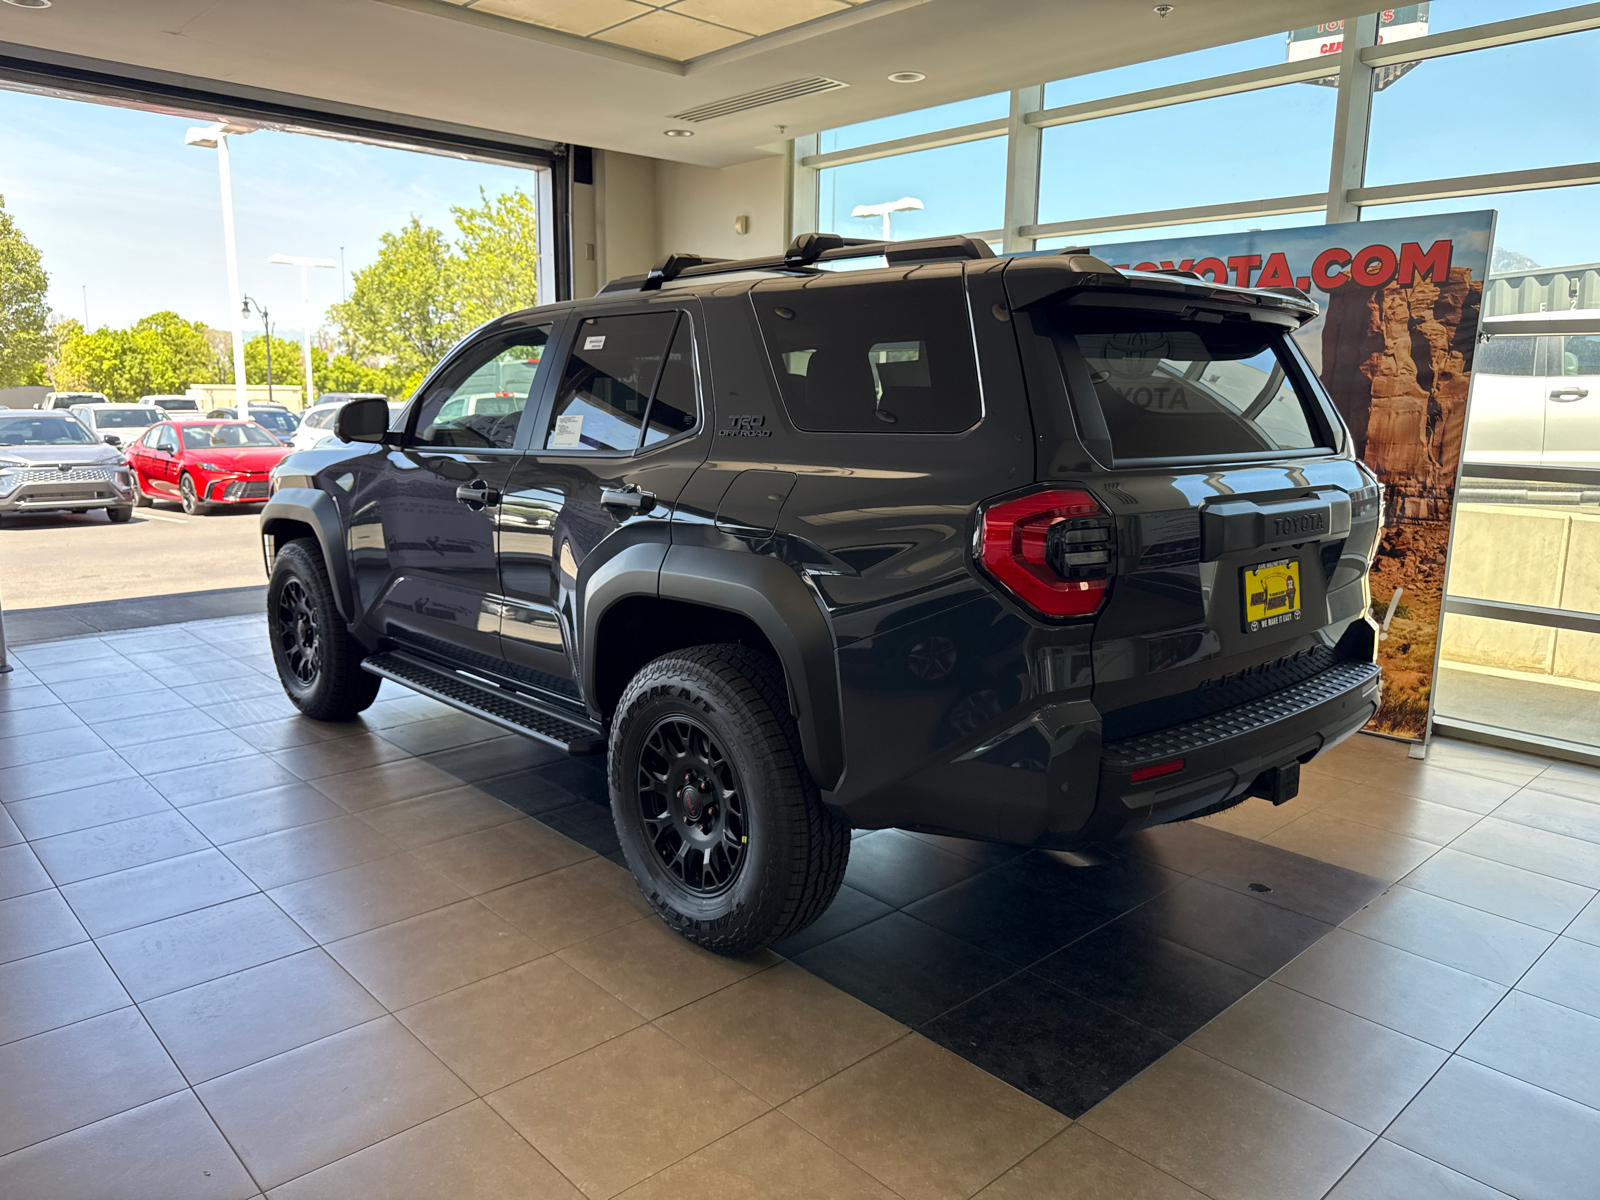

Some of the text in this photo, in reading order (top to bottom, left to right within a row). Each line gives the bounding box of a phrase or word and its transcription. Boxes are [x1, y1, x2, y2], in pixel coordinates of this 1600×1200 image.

[1113, 239, 1453, 289] OTA.COM
[729, 414, 765, 430] TRD
[1274, 512, 1325, 538] TOYOTA
[1261, 619, 1268, 628] WE
[1268, 617, 1278, 626] MAKE
[1283, 613, 1292, 623] EASY
